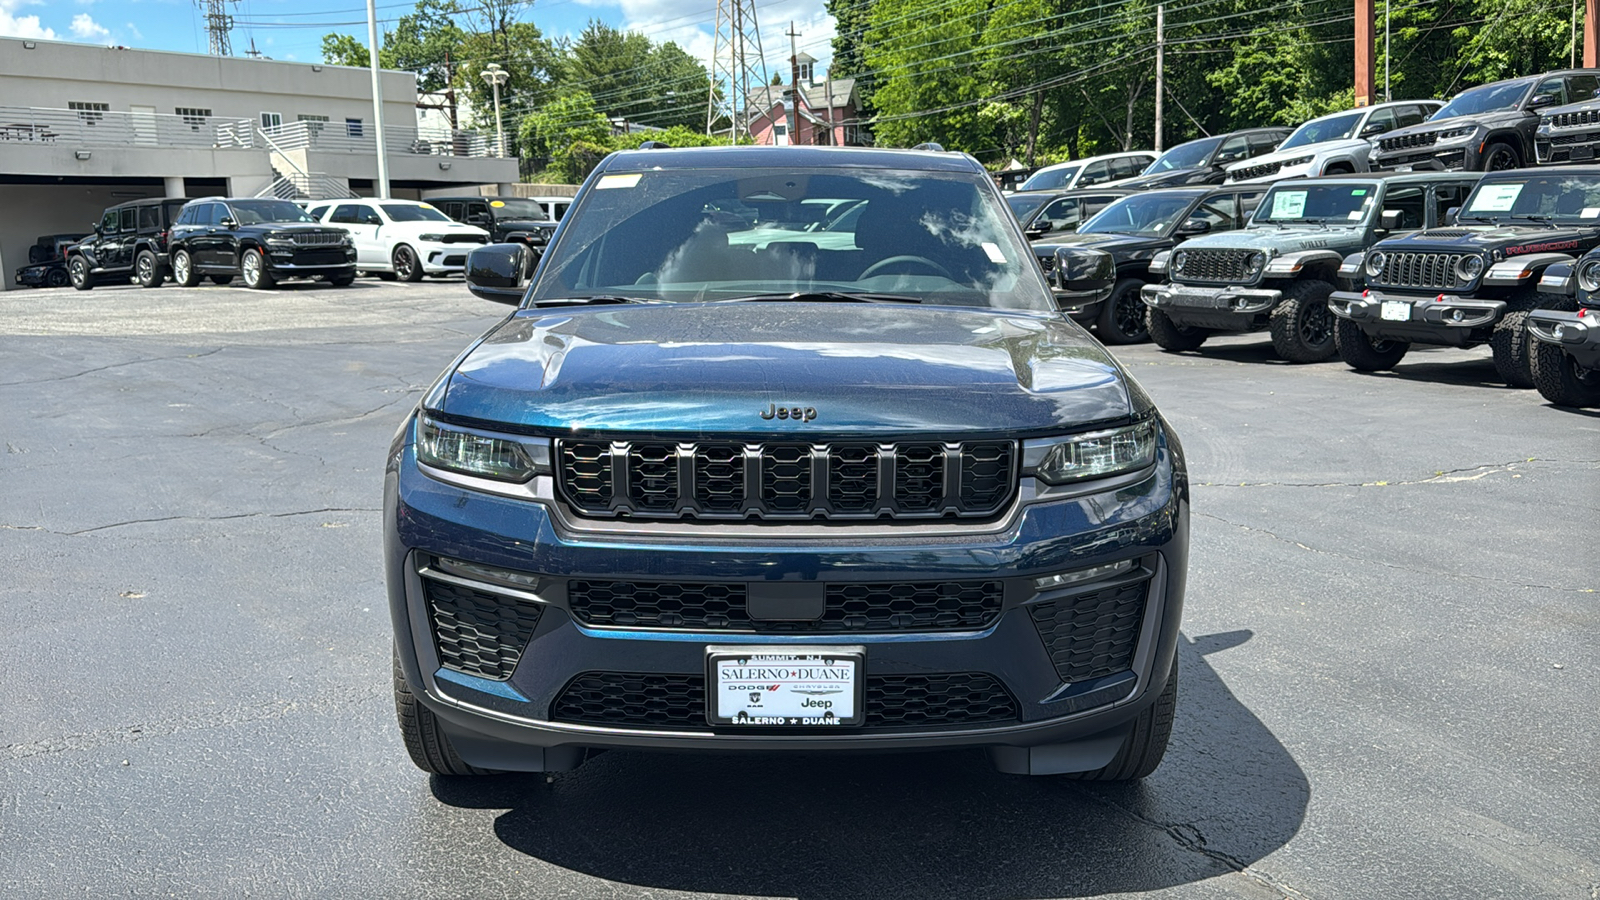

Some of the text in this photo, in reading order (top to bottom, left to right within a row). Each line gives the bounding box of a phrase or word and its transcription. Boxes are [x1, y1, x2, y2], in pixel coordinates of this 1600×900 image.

[1299, 239, 1328, 249] WILLYS
[1506, 241, 1578, 255] RUBICON
[759, 403, 817, 423] Jeep
[722, 668, 850, 680] SALERNO DUANE
[801, 698, 833, 710] Jeep
[731, 716, 841, 725] SALERNO DUANE
